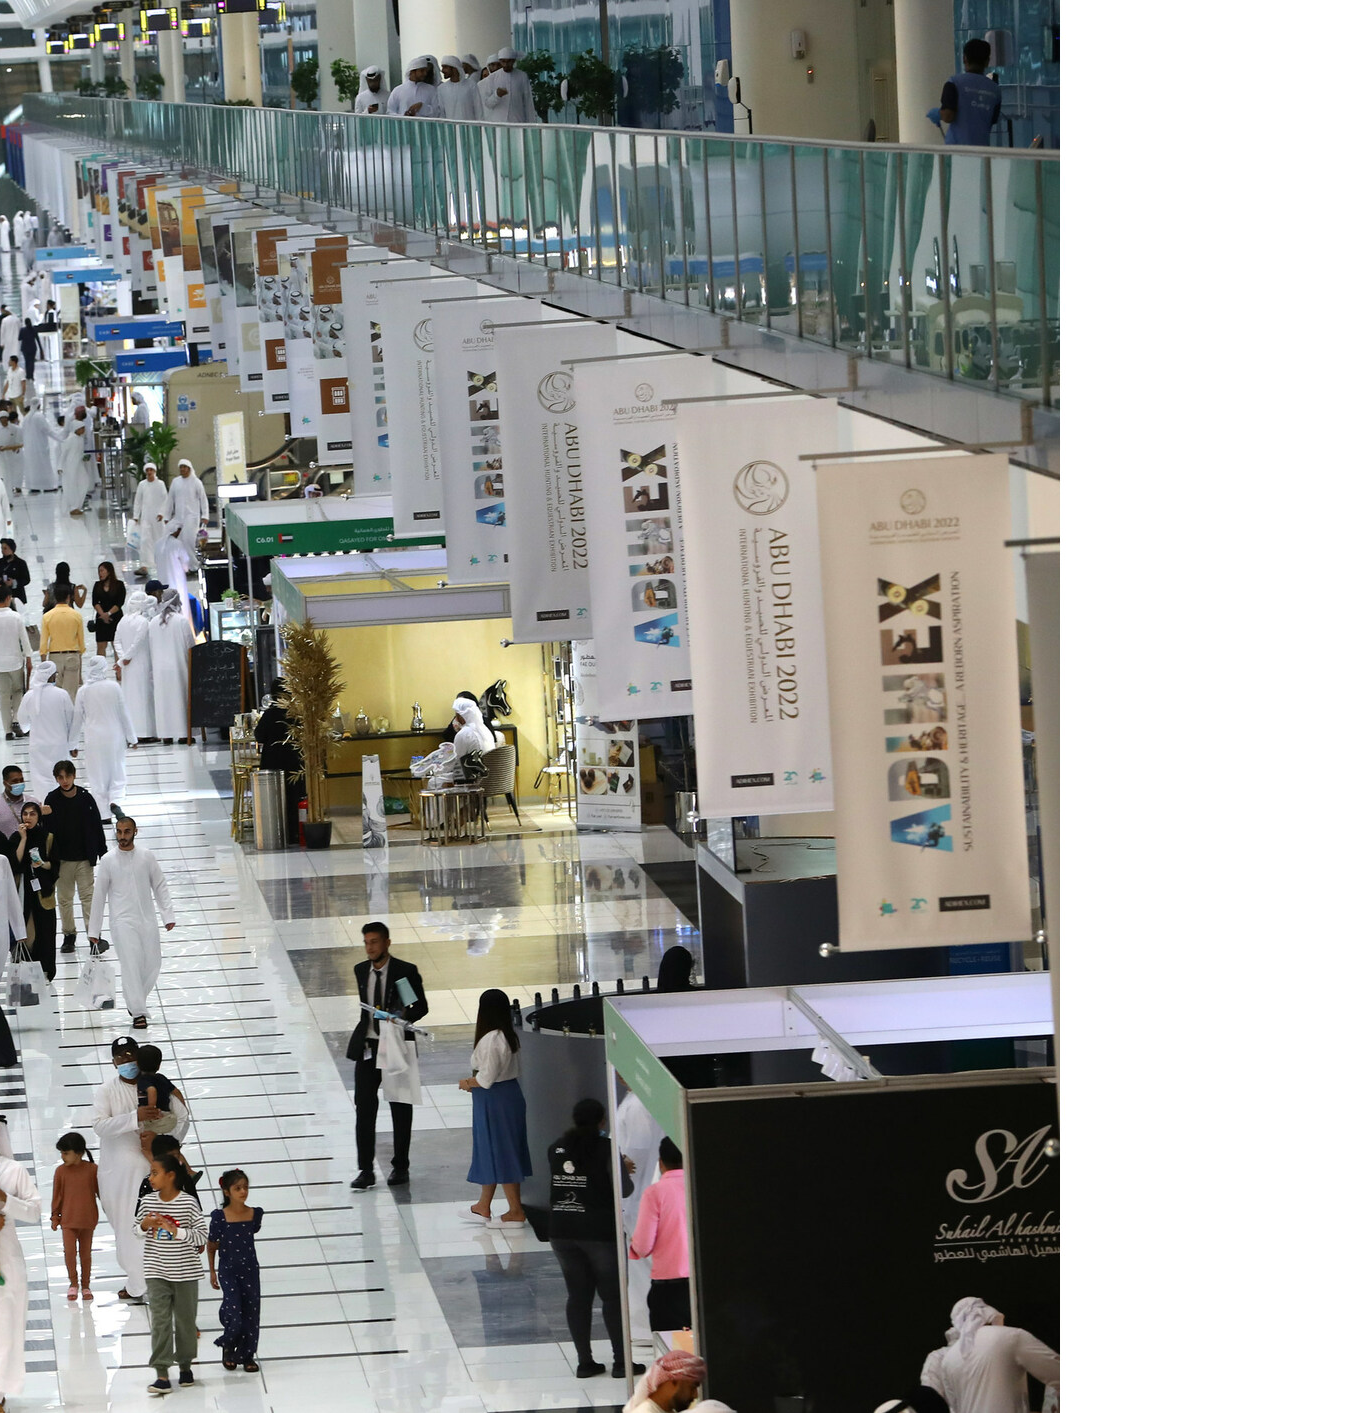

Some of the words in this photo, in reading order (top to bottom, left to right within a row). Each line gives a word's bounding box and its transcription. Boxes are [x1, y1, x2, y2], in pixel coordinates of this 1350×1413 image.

[613, 406, 630, 416] ABU
[630, 404, 658, 414] DHABI
[467, 370, 507, 527] ADIHEX
[540, 423, 550, 468] INTERNATIONAL
[564, 422, 580, 459] ABU
[567, 464, 586, 523] DHABI
[620, 443, 680, 648] ADIHEX
[870, 521, 891, 531] ABU
[894, 518, 931, 530] DHABI
[933, 516, 960, 528] 2022
[570, 527, 589, 570] 2022
[738, 528, 750, 587] INTERNATIONAL
[752, 527, 766, 594] والفروسية
[768, 527, 792, 576] ABU
[742, 588, 752, 623] HUNTING
[756, 596, 768, 636] للصيد
[770, 582, 796, 658] DHABI
[950, 571, 963, 636] ASPIRATION
[744, 633, 756, 680] EQUESTRIAN
[756, 638, 770, 678] الدولي
[953, 637, 965, 682] REBORN
[747, 681, 758, 724] EXHIBITION
[758, 680, 774, 722] المعرض
[776, 664, 800, 720] 2022
[877, 572, 954, 852] ADIHEX
[958, 756, 969, 764] &
[959, 767, 974, 852] SUSTAINABILITY
[936, 1215, 991, 1240] Suhail
[986, 1212, 1017, 1238] Al
[934, 1247, 976, 1263] للعطور
[976, 1245, 1029, 1263] الهاشمي
